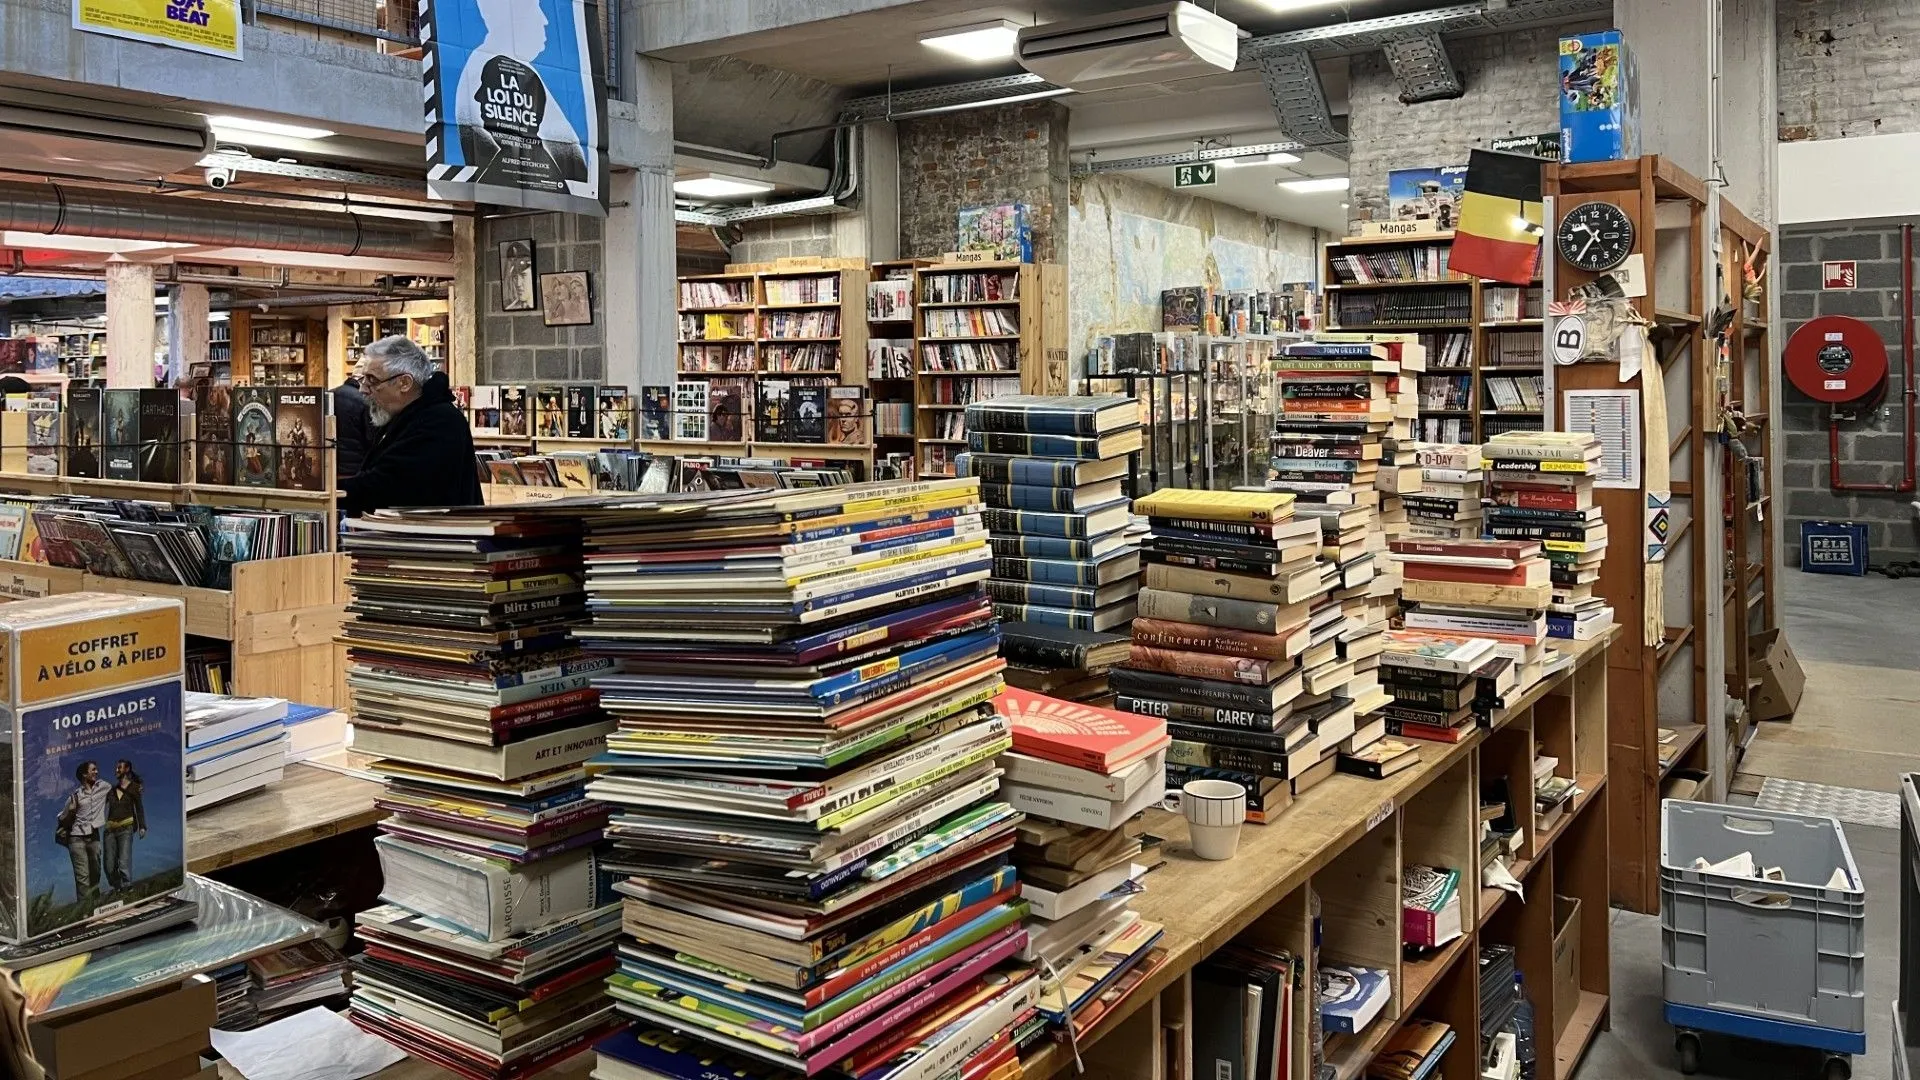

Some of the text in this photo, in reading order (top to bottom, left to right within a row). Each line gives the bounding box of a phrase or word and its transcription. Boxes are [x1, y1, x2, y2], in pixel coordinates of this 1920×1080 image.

[166, 5, 210, 26] BEAT
[500, 74, 520, 90] LA
[487, 87, 533, 109] LOI DU
[484, 103, 538, 127] SILENCE
[1492, 136, 1538, 150] playmobil
[1441, 165, 1468, 176] playm
[1380, 222, 1417, 235] Mangas
[956, 252, 982, 264] Mangas
[1557, 330, 1581, 350] B
[1298, 362, 1324, 370] ALLENDE
[712, 390, 729, 398] ALPHA
[142, 404, 174, 417] CARTHAGO
[1295, 444, 1329, 458] Deaver
[1507, 448, 1562, 458] DARK STAR
[558, 458, 582, 468] BERLIN
[1314, 460, 1338, 469] Perfect
[1426, 454, 1453, 466] D-DAY
[1497, 462, 1537, 470] Leadership
[1170, 519, 1180, 528] THE
[1182, 520, 1200, 530] WORLD
[1201, 522, 1208, 531] OF
[1492, 528, 1516, 536] PORTRAIT
[1812, 536, 1848, 551] PÊLE
[1548, 623, 1566, 632] OGY
[68, 632, 138, 656] COFFRET
[1137, 631, 1212, 648] confinement
[38, 646, 166, 682] À VÉLO & À PIED
[540, 677, 586, 694] LA MER
[1180, 686, 1232, 700] SHAKESPEARE'S
[52, 696, 156, 731] 100 BALADES
[1132, 699, 1255, 727] PETER THEFT CAREY
[75, 723, 109, 738] TRAVERS
[74, 734, 114, 748] PAYSAGES
[535, 735, 607, 761] ART ET INNOVATIO
[1219, 760, 1262, 770] ROBERTSON
[1080, 806, 1103, 816] FAYARD
[504, 876, 512, 934] LAROUSSE
